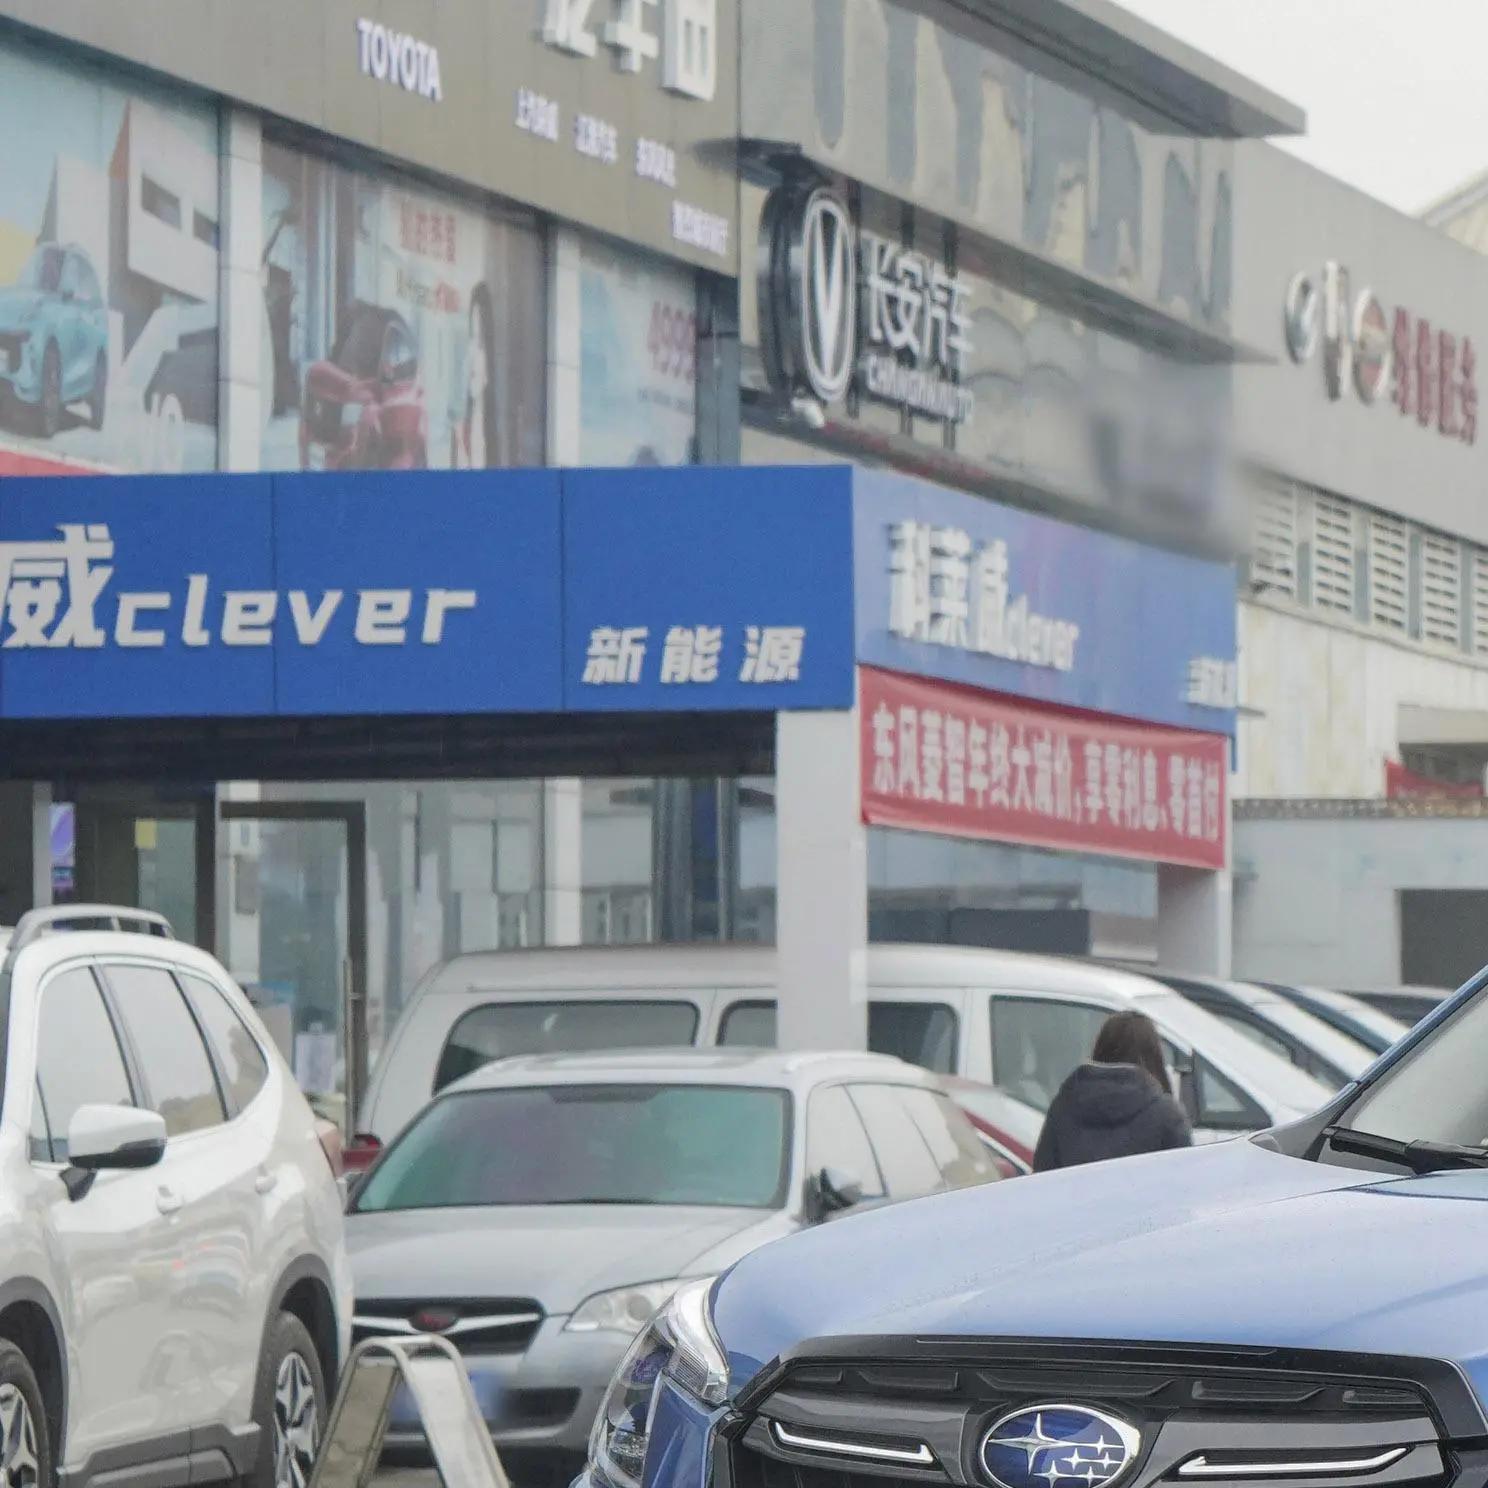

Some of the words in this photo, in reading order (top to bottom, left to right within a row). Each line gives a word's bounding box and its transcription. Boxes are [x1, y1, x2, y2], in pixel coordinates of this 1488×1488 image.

[357, 18, 442, 101] TOYOTA
[582, 626, 805, 685] 新能源
